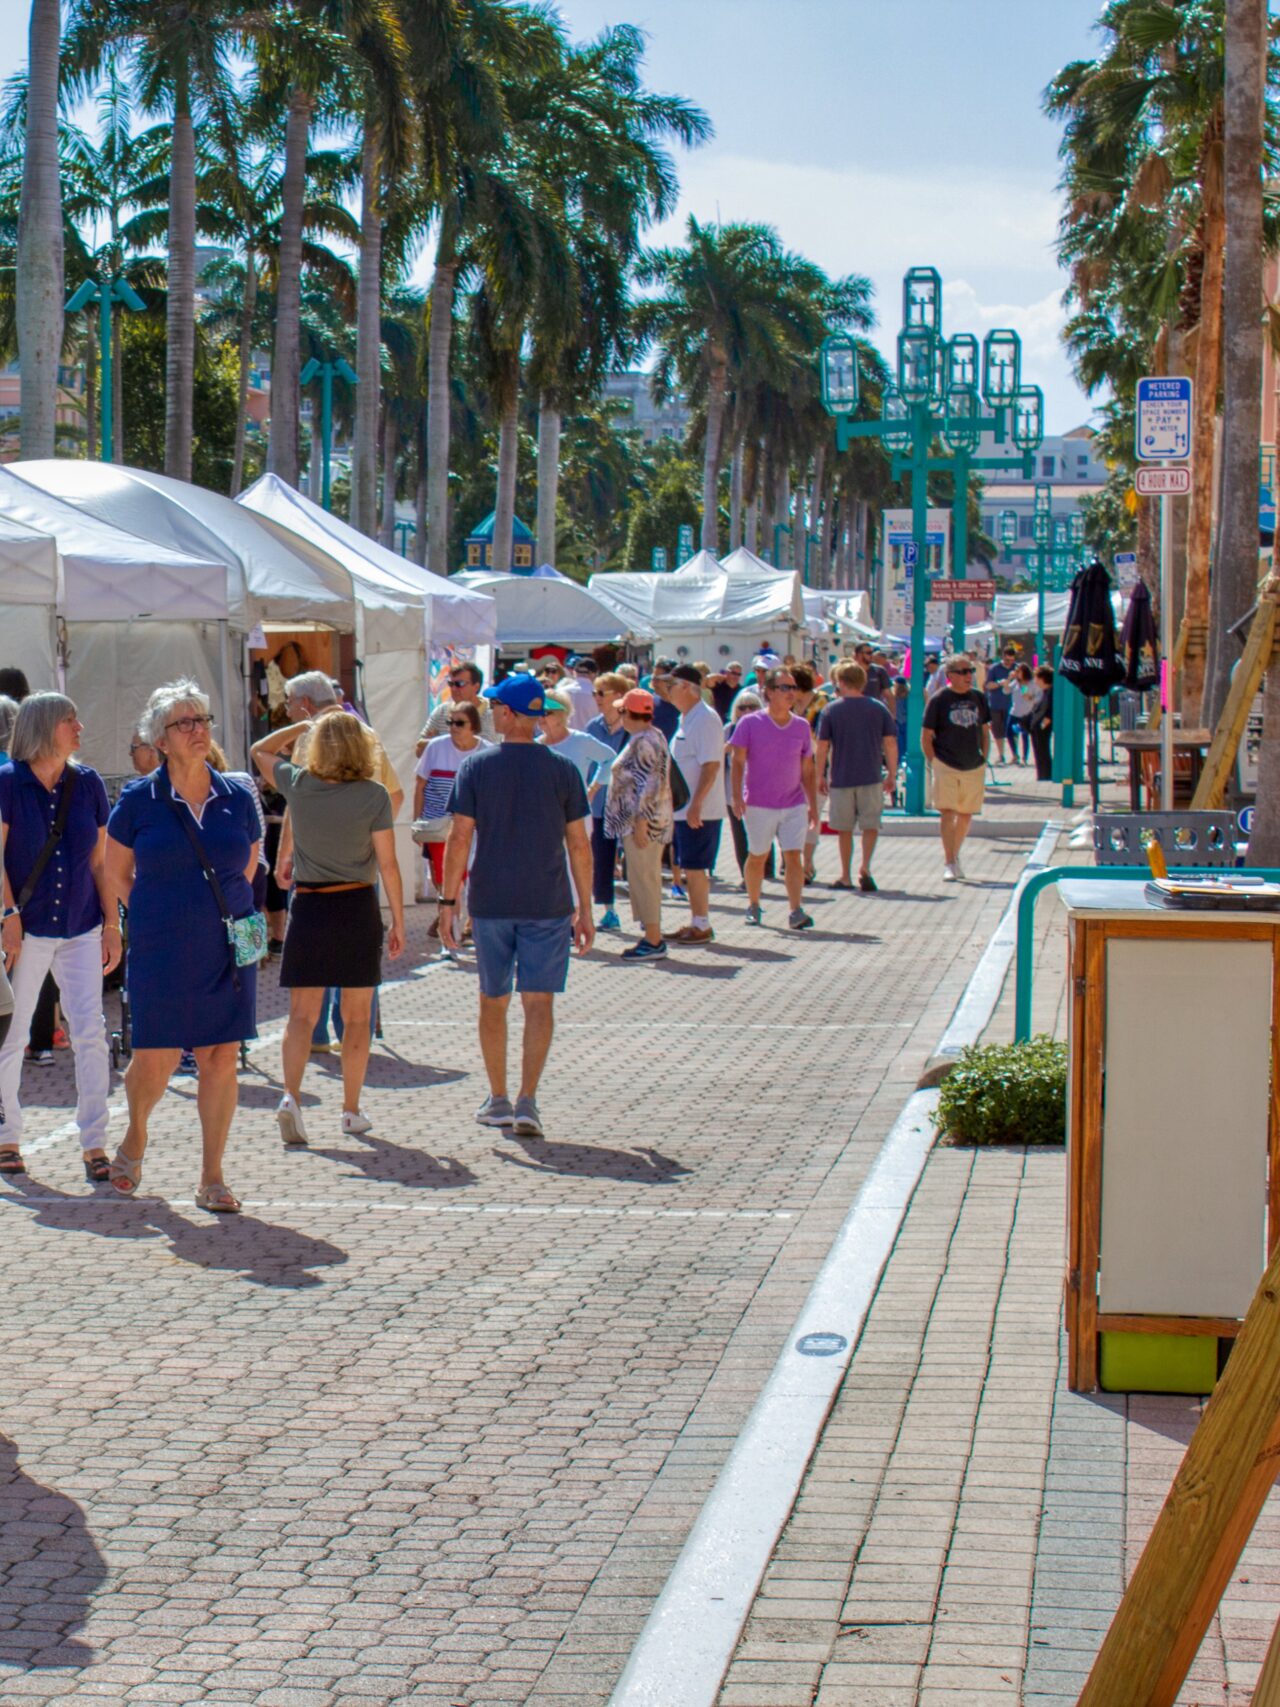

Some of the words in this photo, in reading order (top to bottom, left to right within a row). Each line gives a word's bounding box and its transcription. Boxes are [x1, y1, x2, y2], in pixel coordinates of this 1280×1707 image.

[1148, 382, 1181, 390] METERED
[1148, 390, 1180, 398] PARKING
[1155, 416, 1172, 424] PAY
[1148, 474, 1166, 488] HOUR
